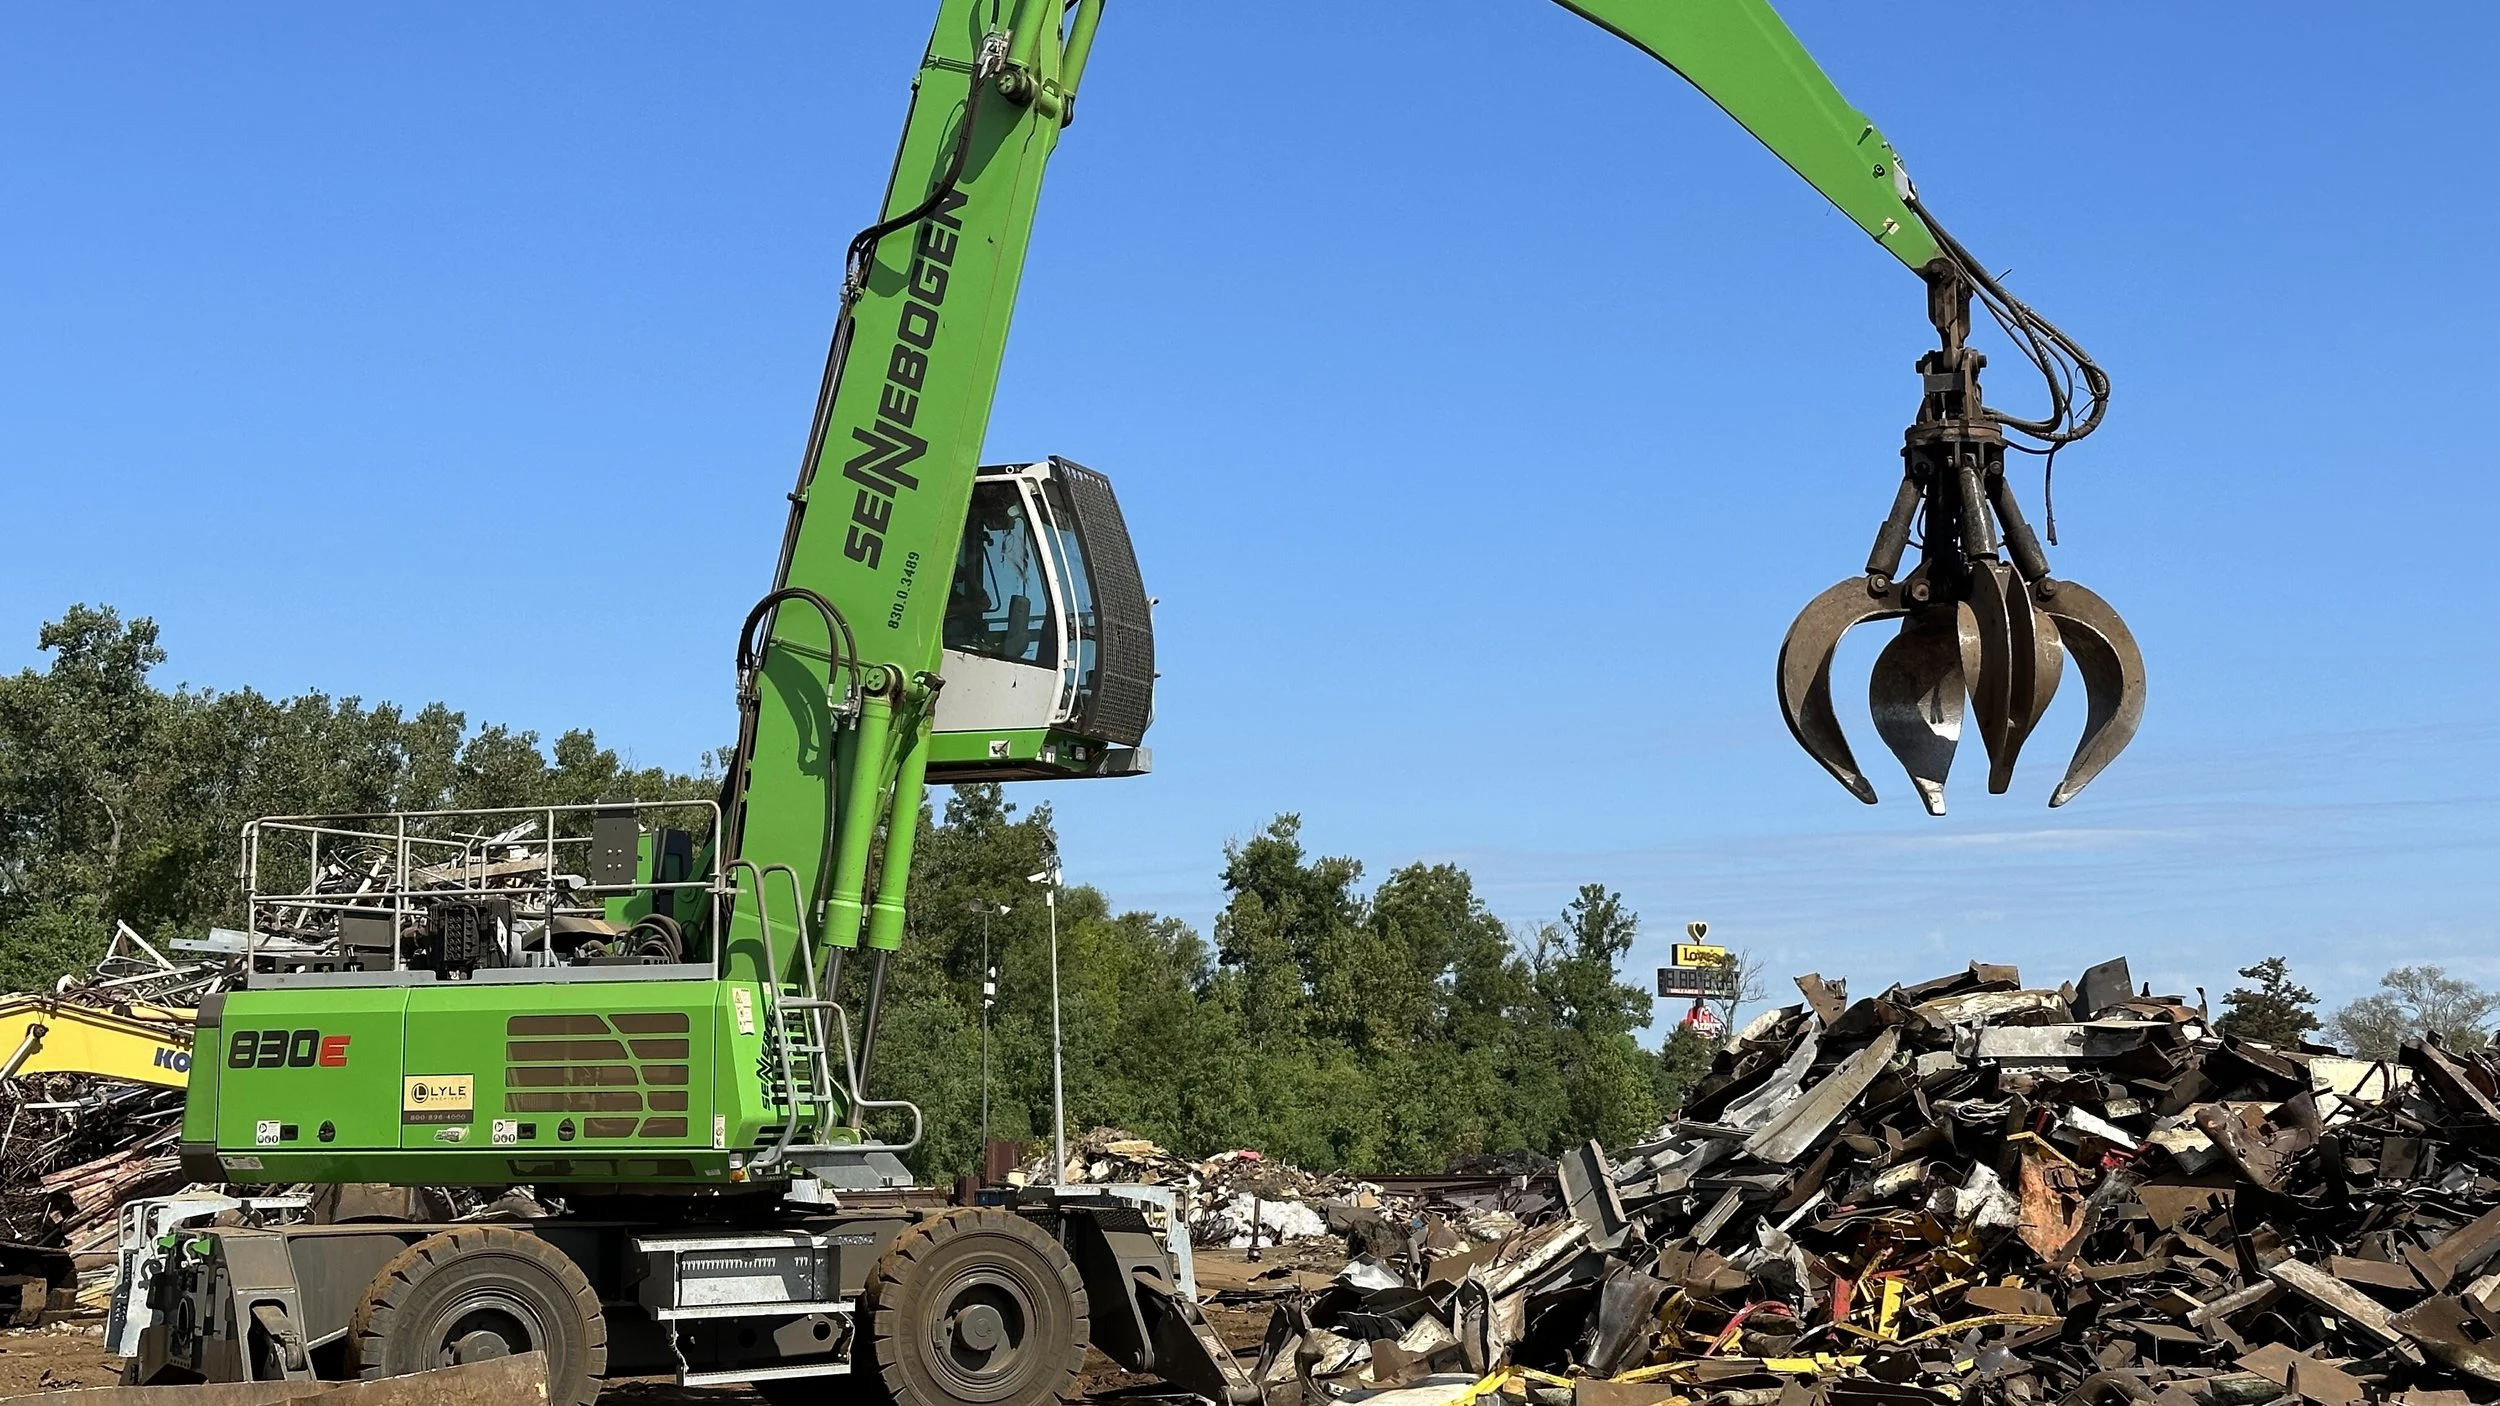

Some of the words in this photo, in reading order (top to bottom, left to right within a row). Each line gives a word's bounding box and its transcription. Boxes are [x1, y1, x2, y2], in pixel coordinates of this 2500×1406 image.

[843, 182, 969, 571] SENNEBOGEN
[888, 551, 920, 629] 830.0.3489
[228, 1030, 351, 1068] 830E
[430, 1086, 466, 1096] LYLE
